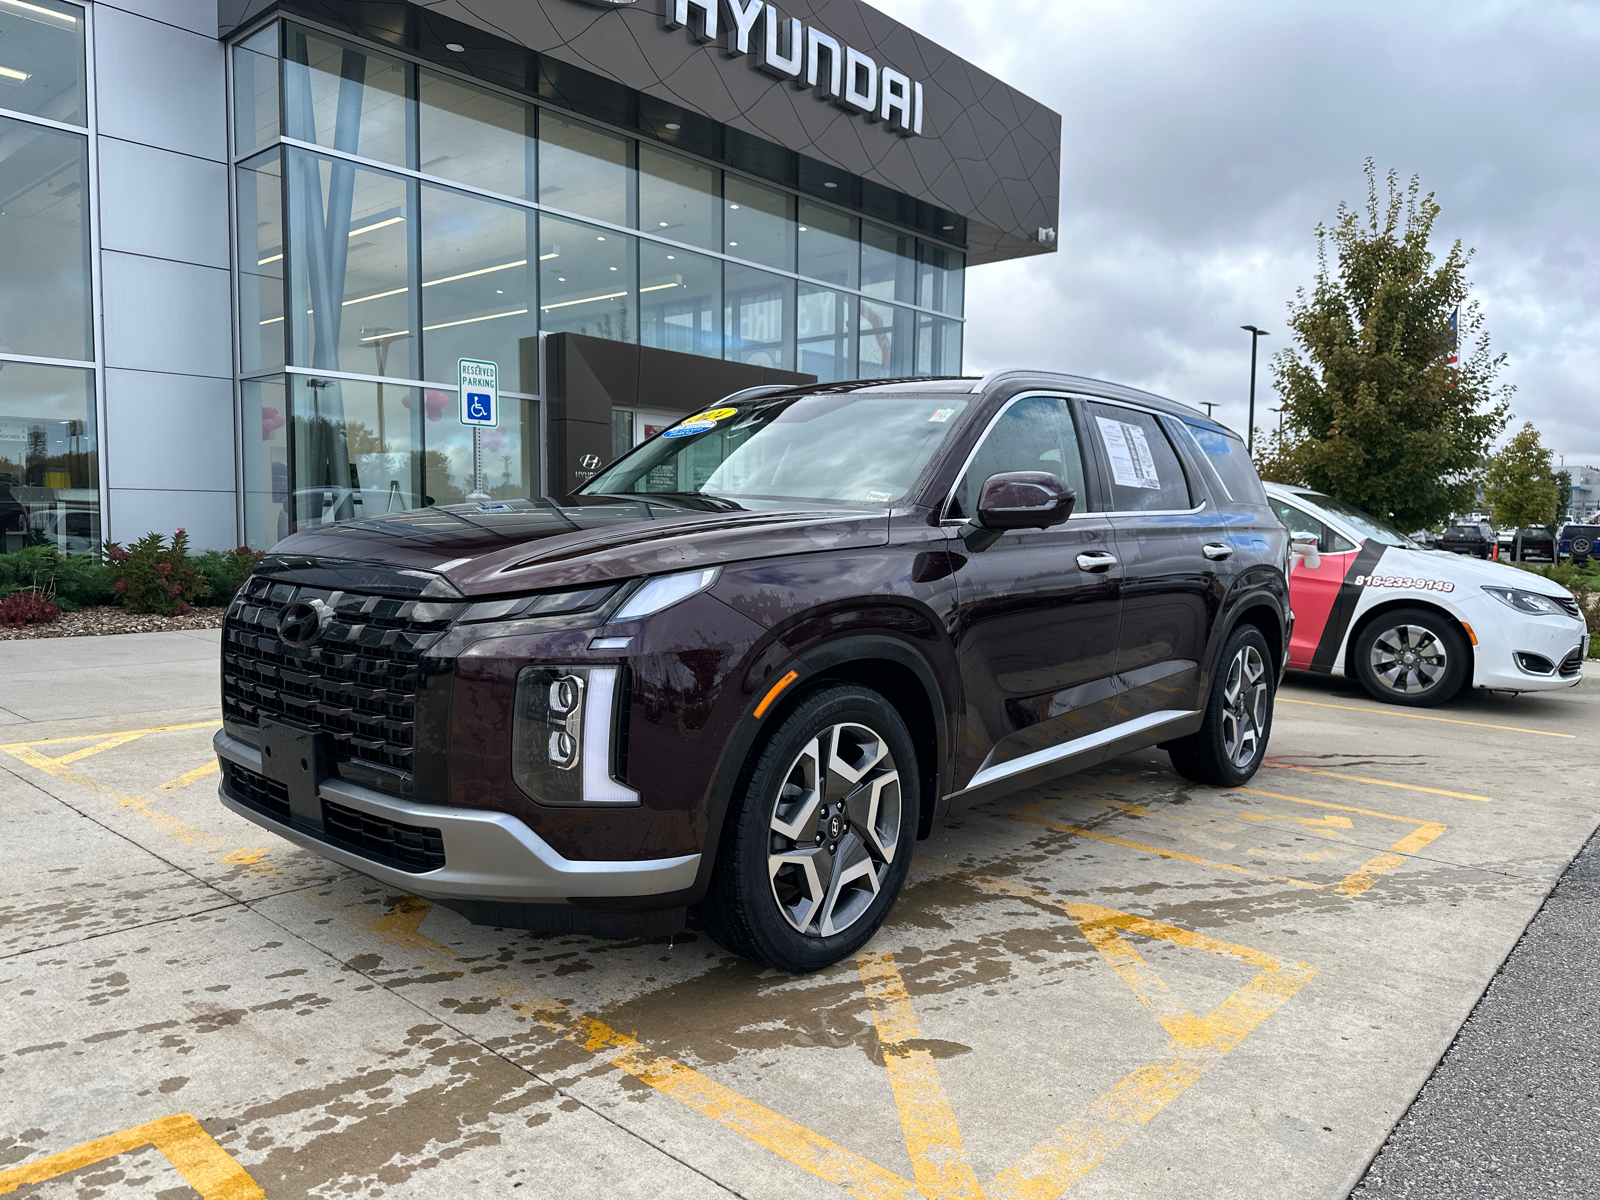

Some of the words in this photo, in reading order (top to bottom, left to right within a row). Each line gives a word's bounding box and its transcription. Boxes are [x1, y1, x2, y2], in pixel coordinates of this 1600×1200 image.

[462, 364, 494, 378] RESERVED
[462, 376, 495, 389] PARKING
[1354, 575, 1455, 593] 816-233-9149
